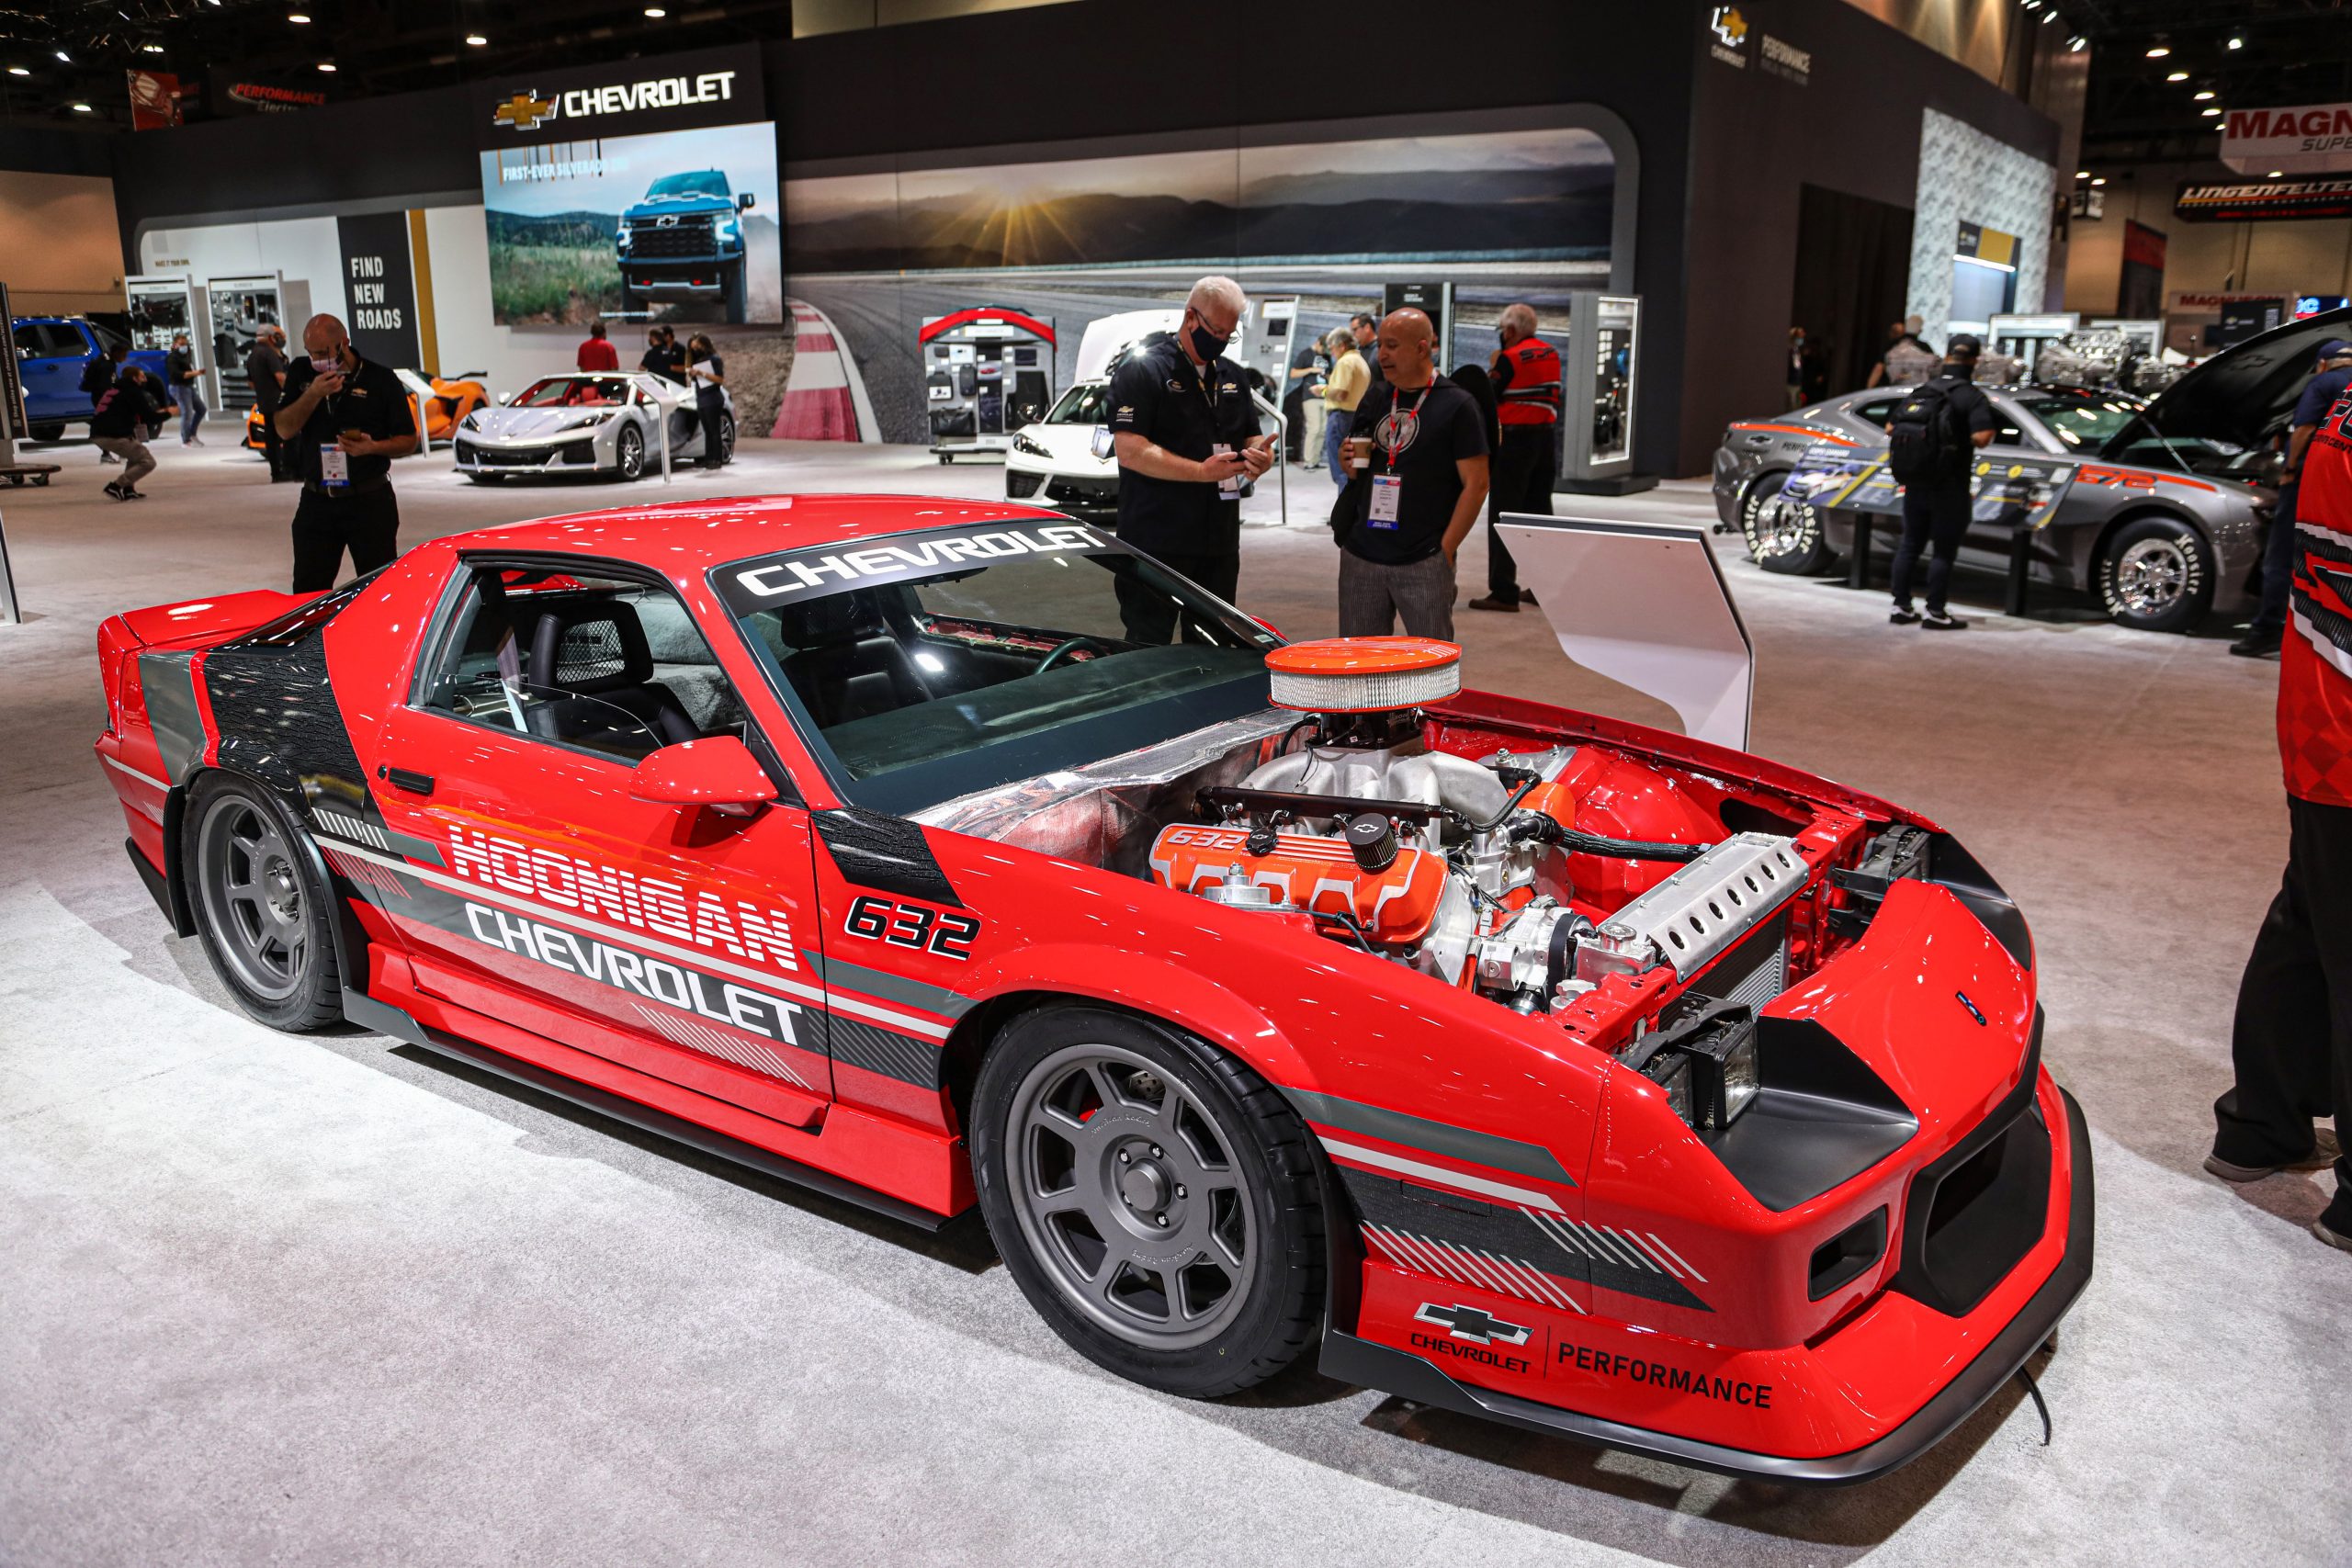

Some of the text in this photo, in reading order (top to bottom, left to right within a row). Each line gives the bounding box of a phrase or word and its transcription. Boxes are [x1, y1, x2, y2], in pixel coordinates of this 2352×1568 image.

[235, 84, 325, 106] PERFORMANCE
[564, 71, 735, 118] CHEVROLET
[351, 256, 383, 278] FIND
[354, 283, 384, 304] NEW
[356, 308, 402, 330] ROADS
[735, 525, 1107, 597] CHEVROLET
[2174, 533, 2204, 595] Hoosier
[1167, 830, 1246, 851] 632
[447, 825, 799, 972] HOONIGAN
[843, 895, 982, 962] 632
[465, 901, 802, 1046] CHEVROLET
[1409, 1332, 1532, 1375] CHEVROLET
[1556, 1342, 1774, 1409] PERFORMANCE
